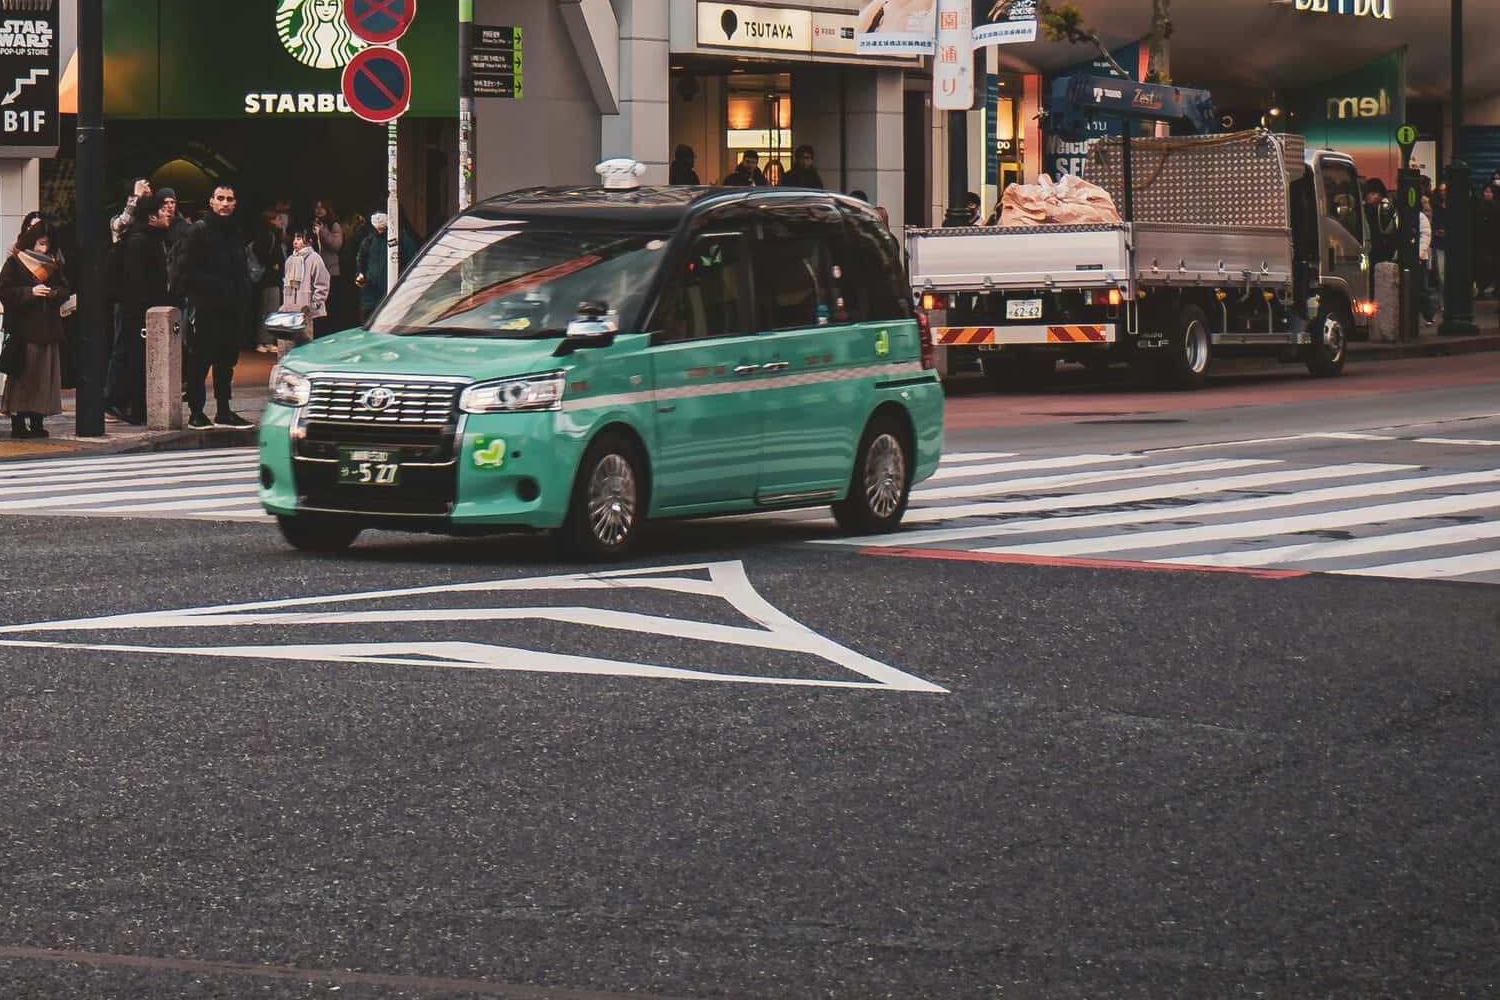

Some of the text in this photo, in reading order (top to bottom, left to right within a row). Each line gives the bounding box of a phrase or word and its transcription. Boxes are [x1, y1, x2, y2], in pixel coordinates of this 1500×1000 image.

[745, 21, 793, 39] TSUTAYA
[0, 48, 49, 56] POP-UP STORE
[244, 93, 409, 113] STARBU
[4, 110, 45, 132] B1F
